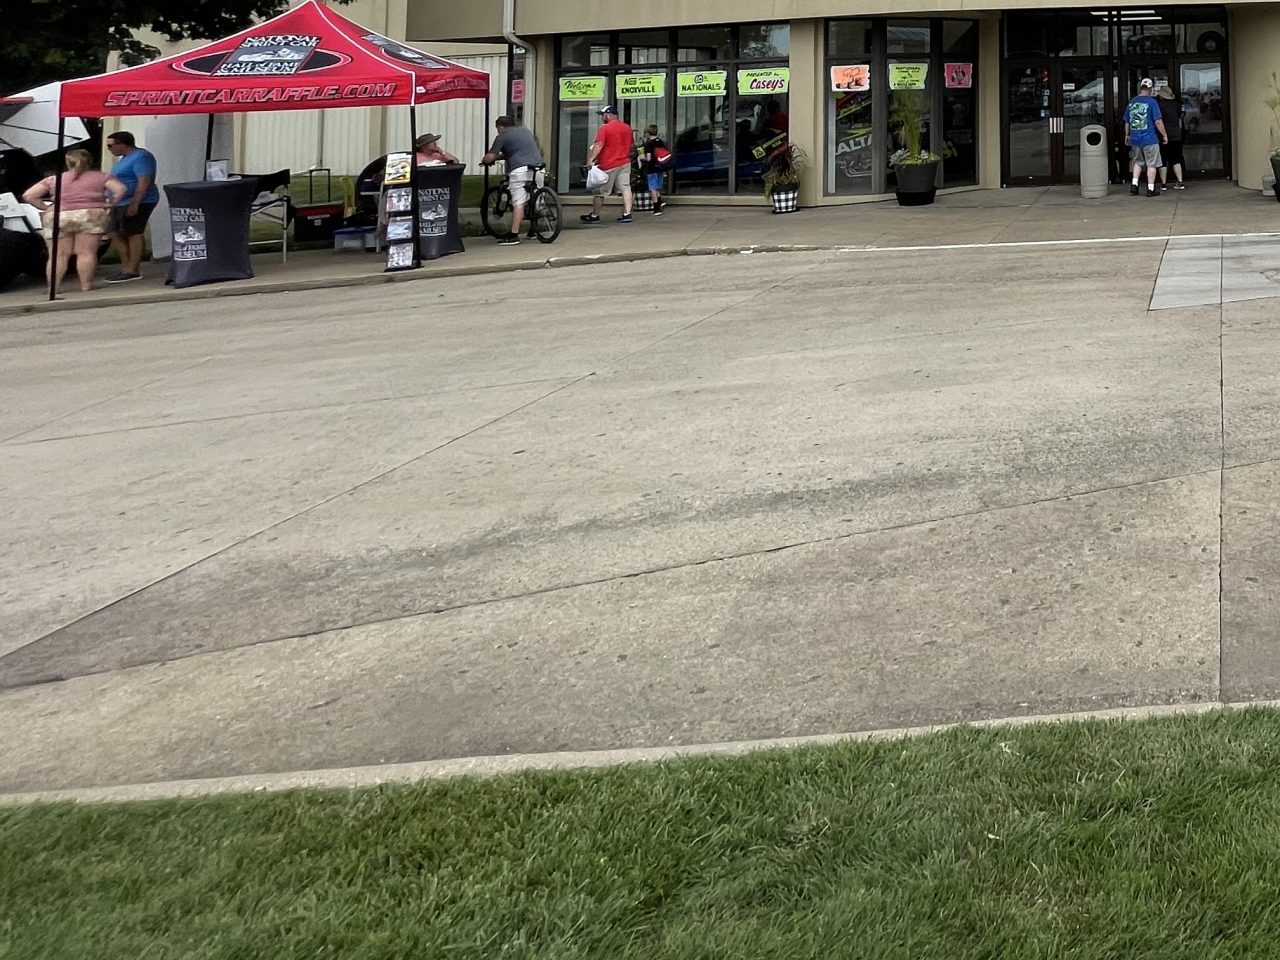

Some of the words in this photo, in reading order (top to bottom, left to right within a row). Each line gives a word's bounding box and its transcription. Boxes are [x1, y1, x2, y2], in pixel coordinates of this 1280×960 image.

[245, 35, 319, 43] NATIONAL
[564, 80, 596, 91] Welcome
[621, 85, 656, 94] KNOXVILLE
[681, 83, 721, 92] NATIONALS
[749, 78, 785, 92] Casey's
[104, 83, 397, 107] SPRINTCARRAFFLE.COM
